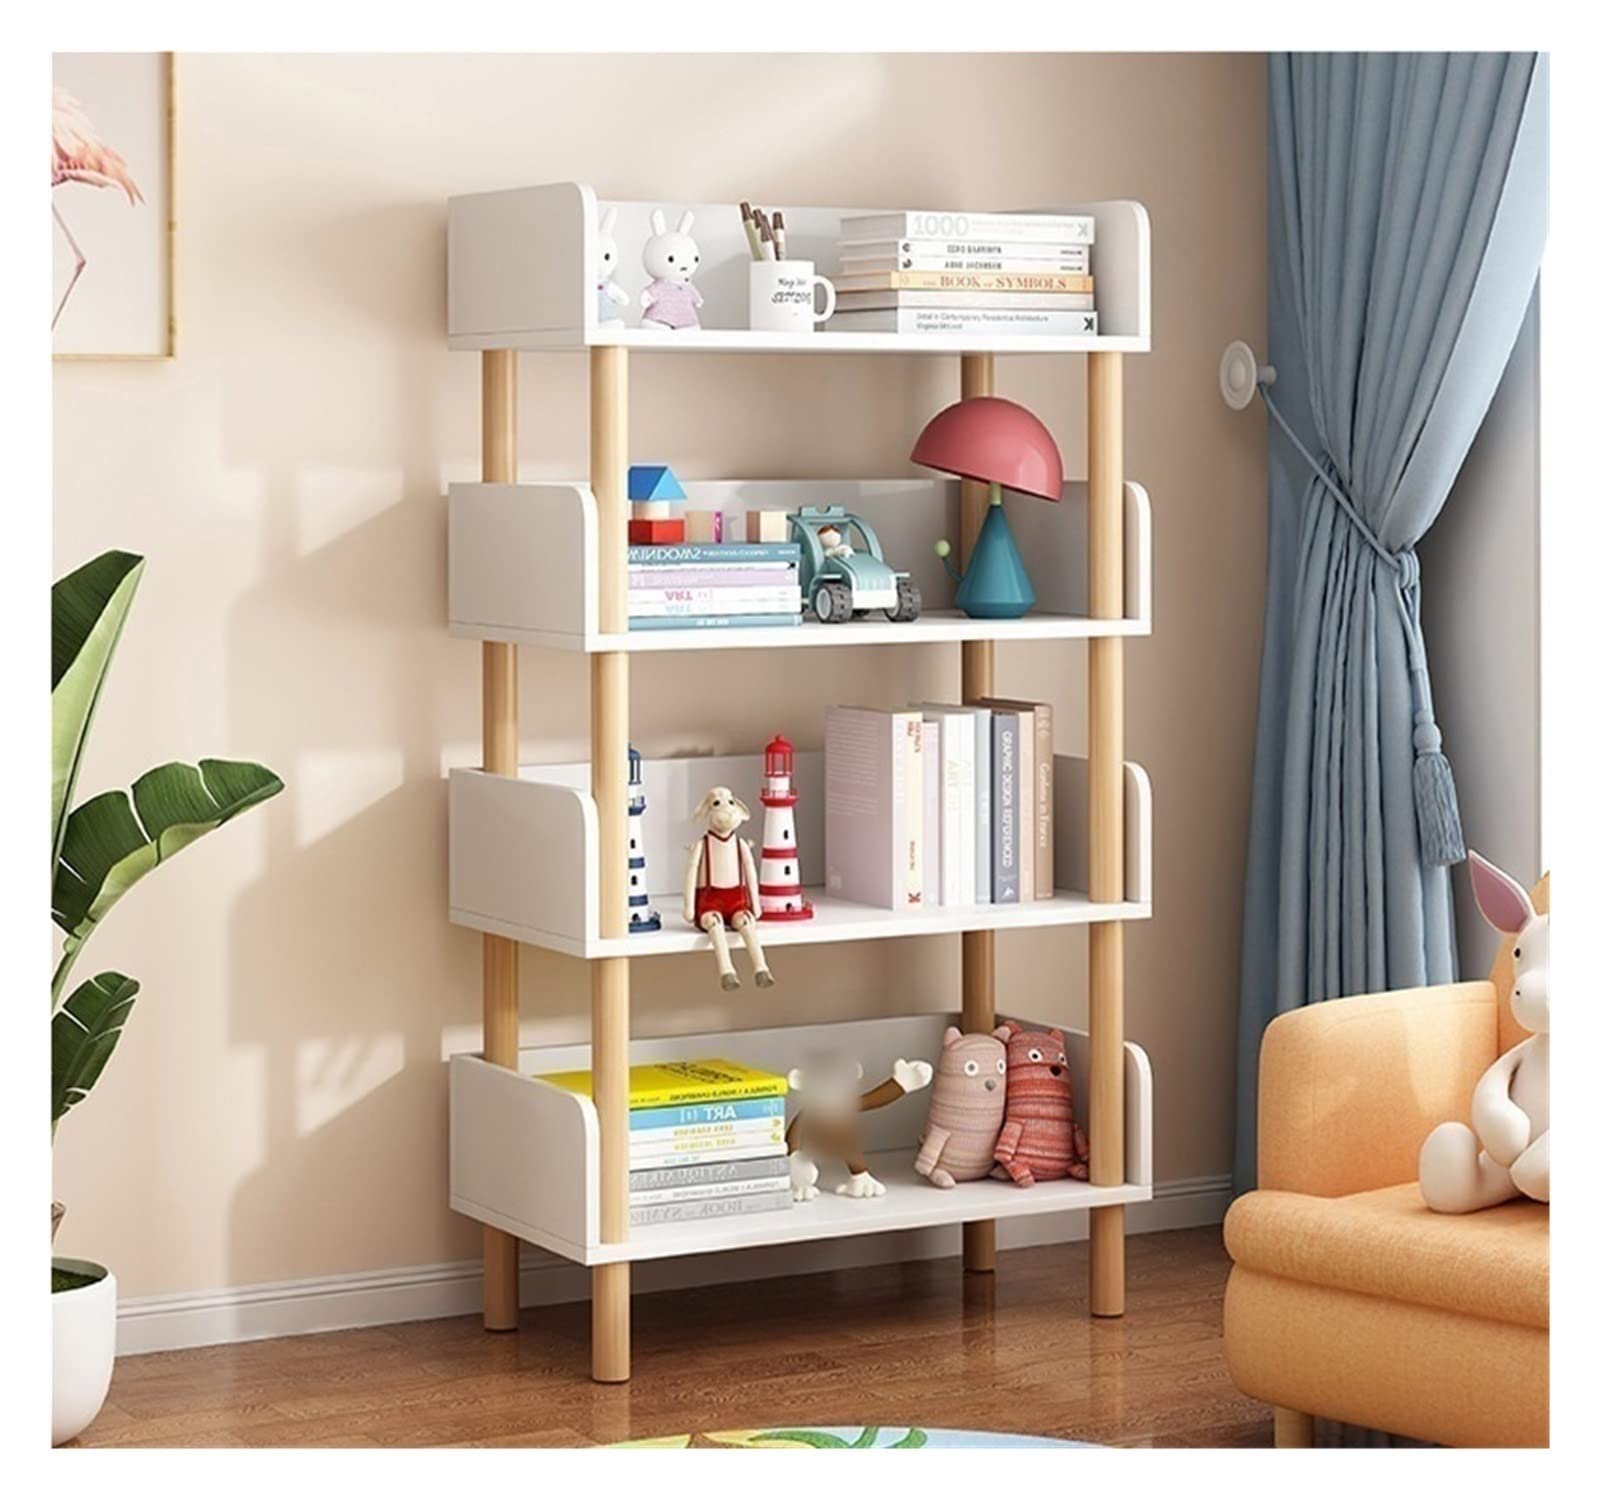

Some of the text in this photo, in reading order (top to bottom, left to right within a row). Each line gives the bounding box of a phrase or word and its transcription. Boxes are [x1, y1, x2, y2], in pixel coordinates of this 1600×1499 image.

[913, 215, 969, 236] 1000
[940, 276, 981, 289] BOOK
[995, 277, 1067, 290] SYMBOLS
[1001, 731, 1013, 771] GRAPHIC
